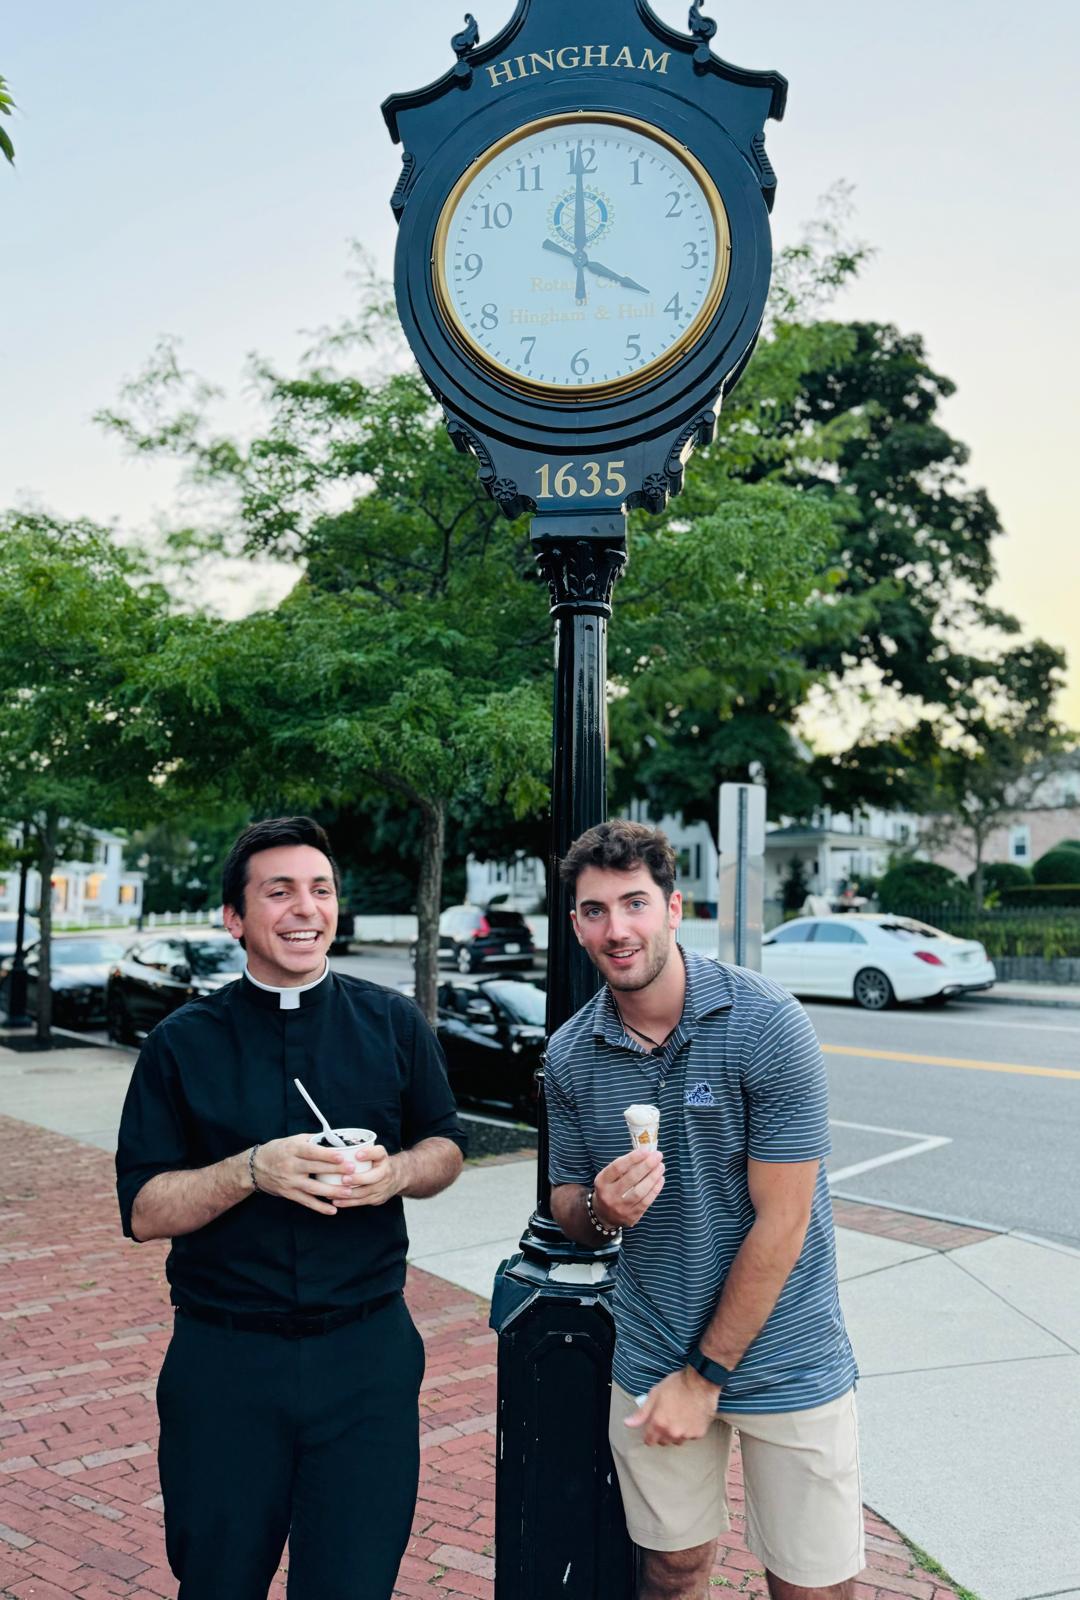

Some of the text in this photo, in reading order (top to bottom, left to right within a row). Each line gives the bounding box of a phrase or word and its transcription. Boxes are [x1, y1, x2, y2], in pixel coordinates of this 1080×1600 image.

[485, 44, 672, 88] HINGHAM
[566, 148, 598, 175] 12
[630, 158, 643, 186] 1
[516, 164, 544, 192] 11
[480, 202, 513, 230] 10
[664, 191, 683, 219] 2
[464, 253, 483, 281] 9
[681, 241, 699, 270] 3
[480, 303, 499, 330] 8
[508, 300, 657, 326] Hingham & Hull
[663, 291, 683, 321] 4
[520, 336, 537, 365] 7
[623, 333, 641, 361] 5
[570, 348, 590, 376] 6
[535, 460, 627, 498] 1635
